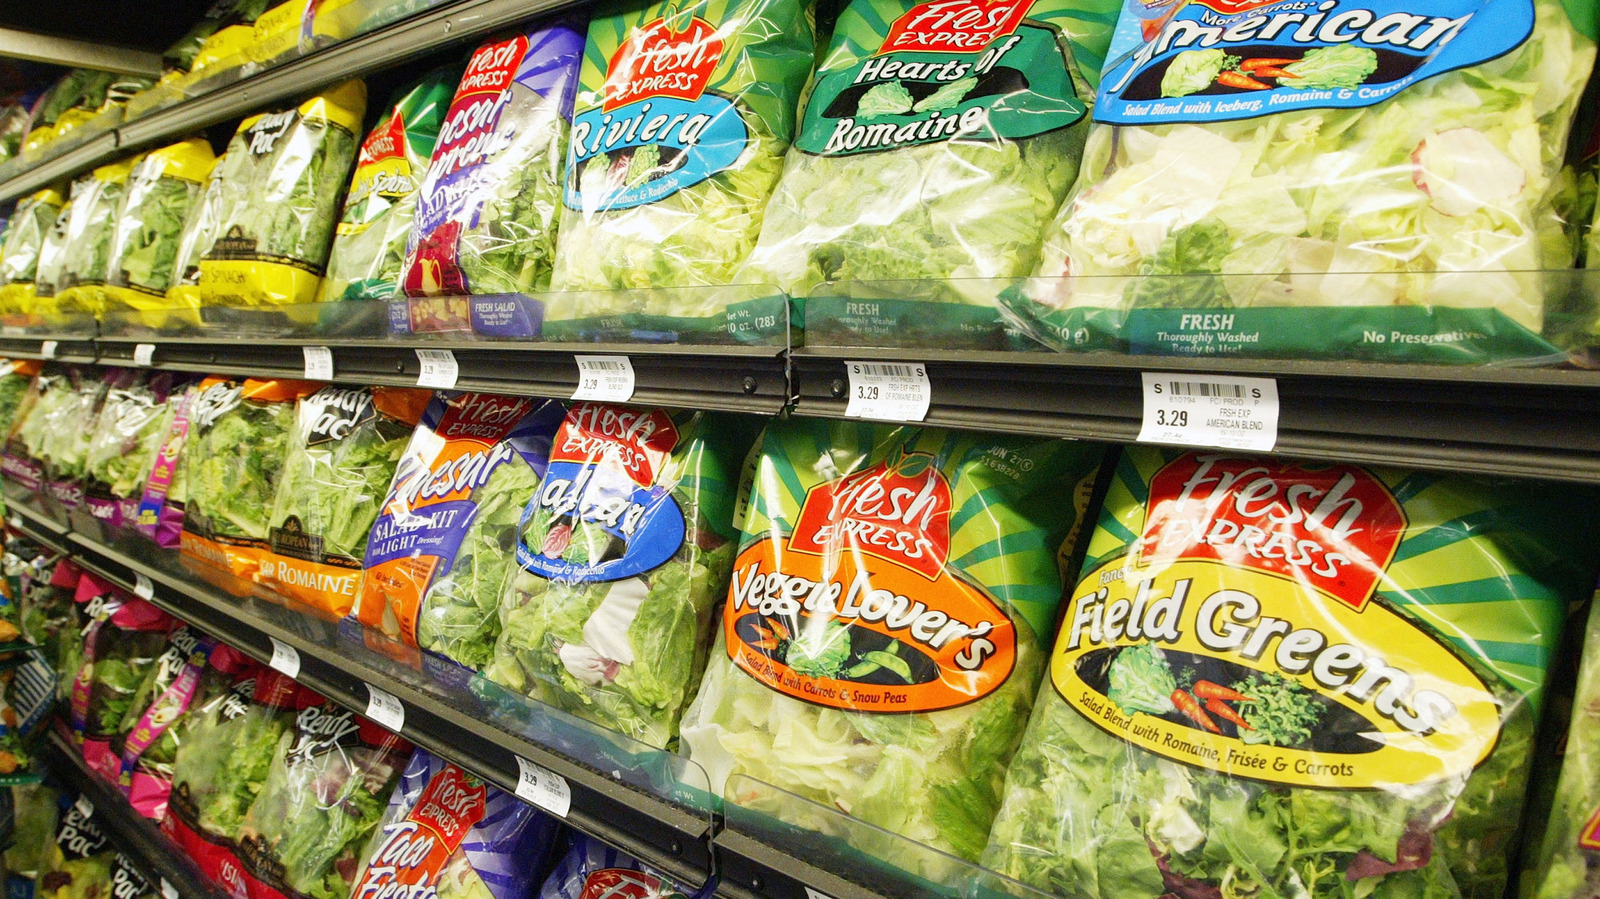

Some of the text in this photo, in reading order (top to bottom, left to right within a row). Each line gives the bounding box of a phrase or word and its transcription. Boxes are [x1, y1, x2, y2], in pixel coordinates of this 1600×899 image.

[907, 0, 1006, 31] Fres
[1201, 10, 1241, 27] More
[622, 26, 708, 78] Fresh
[893, 31, 996, 47] EXPRES
[469, 37, 518, 75] resh
[973, 35, 1021, 74] of
[462, 70, 508, 91] XPRESS
[855, 57, 973, 84] Hearts
[614, 71, 699, 101] EXPRESS
[1122, 75, 1414, 117] Salad Blend with Iceberg, Romaine & Carrots
[436, 89, 513, 151] aesar
[573, 103, 713, 158] Riviera
[825, 106, 986, 152] Romaine
[737, 309, 751, 319] Wt.
[754, 315, 776, 330] (283
[846, 302, 880, 317] FRESH
[1180, 314, 1235, 331] FRESH
[1157, 331, 1260, 344] Thoroughly Washed
[1363, 330, 1386, 344] No
[853, 365, 924, 377] S S
[858, 385, 879, 400] 3.29
[1154, 383, 1261, 399] S S
[459, 393, 524, 424] Fresh
[1156, 408, 1188, 427] 3.29
[1219, 407, 1252, 418] FRSH EXP
[447, 422, 503, 438] EXPRESS
[573, 402, 657, 448] Fresh
[1206, 418, 1263, 430] AMERICAN BLEND
[987, 446, 1009, 460] JUN
[826, 475, 937, 531] Fresh
[1174, 453, 1364, 543] Fresh
[427, 509, 459, 530] KIT
[381, 534, 418, 556] LIGHT
[812, 517, 932, 559] EXPRESS
[1162, 516, 1350, 580] EXPRESS
[732, 563, 996, 671] Veggie Lover's
[1066, 579, 1457, 732] Field Greens
[745, 653, 762, 672] Salad
[784, 674, 802, 690] with
[803, 681, 837, 699] Carrots
[853, 690, 880, 703] Snow
[884, 691, 908, 704] Peas
[1079, 691, 1354, 778] Salad Blend with Romaine, Frisée & Carrots
[432, 768, 482, 819] Fresh
[524, 771, 538, 786] 3.29
[420, 802, 460, 837] EXPRESS
[57, 824, 95, 858] Pac
[369, 821, 435, 868] Taco
